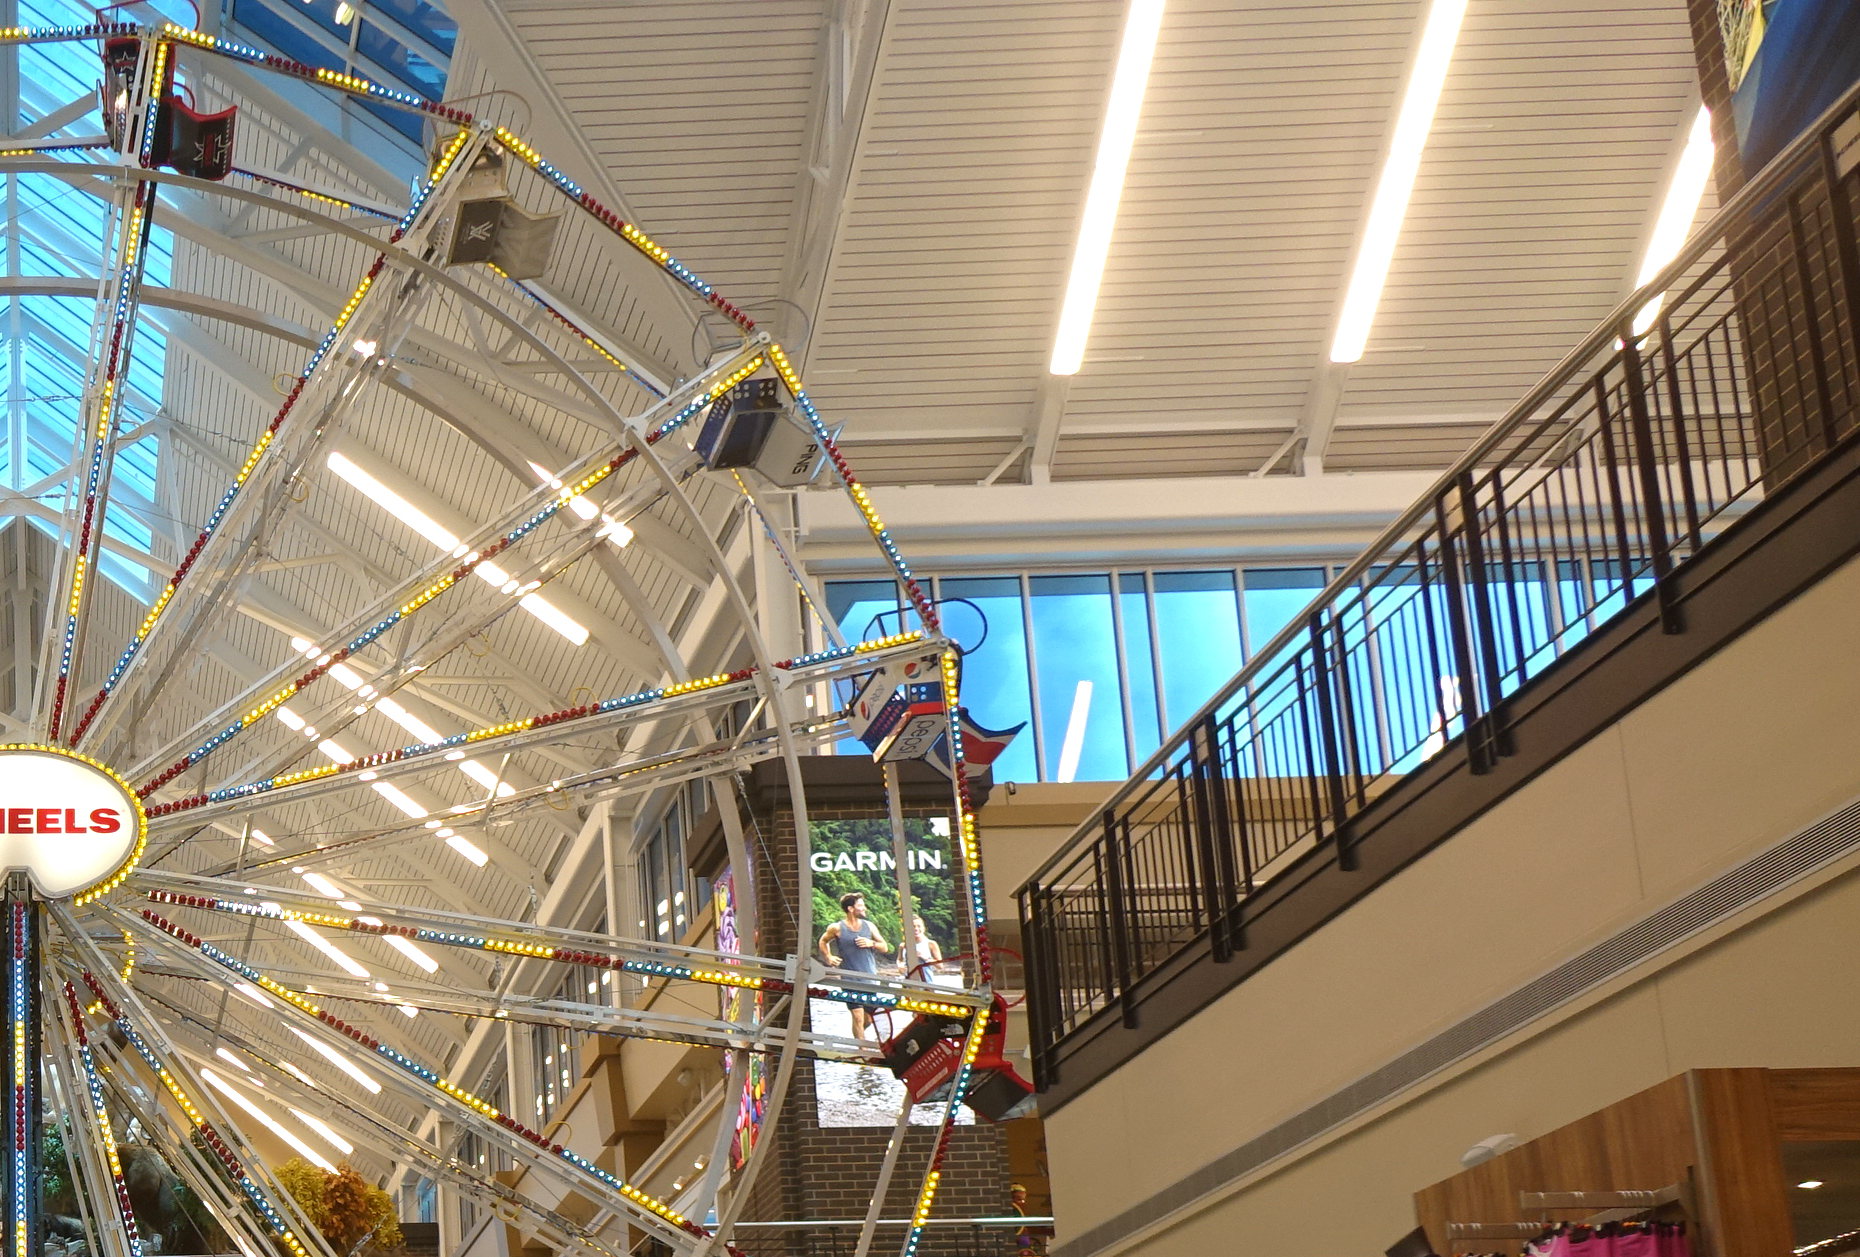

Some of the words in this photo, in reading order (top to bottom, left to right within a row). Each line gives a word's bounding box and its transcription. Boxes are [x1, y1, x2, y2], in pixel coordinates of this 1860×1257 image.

[792, 444, 818, 474] PING
[900, 719, 935, 755] pepsi
[810, 850, 941, 872] GARMIN
